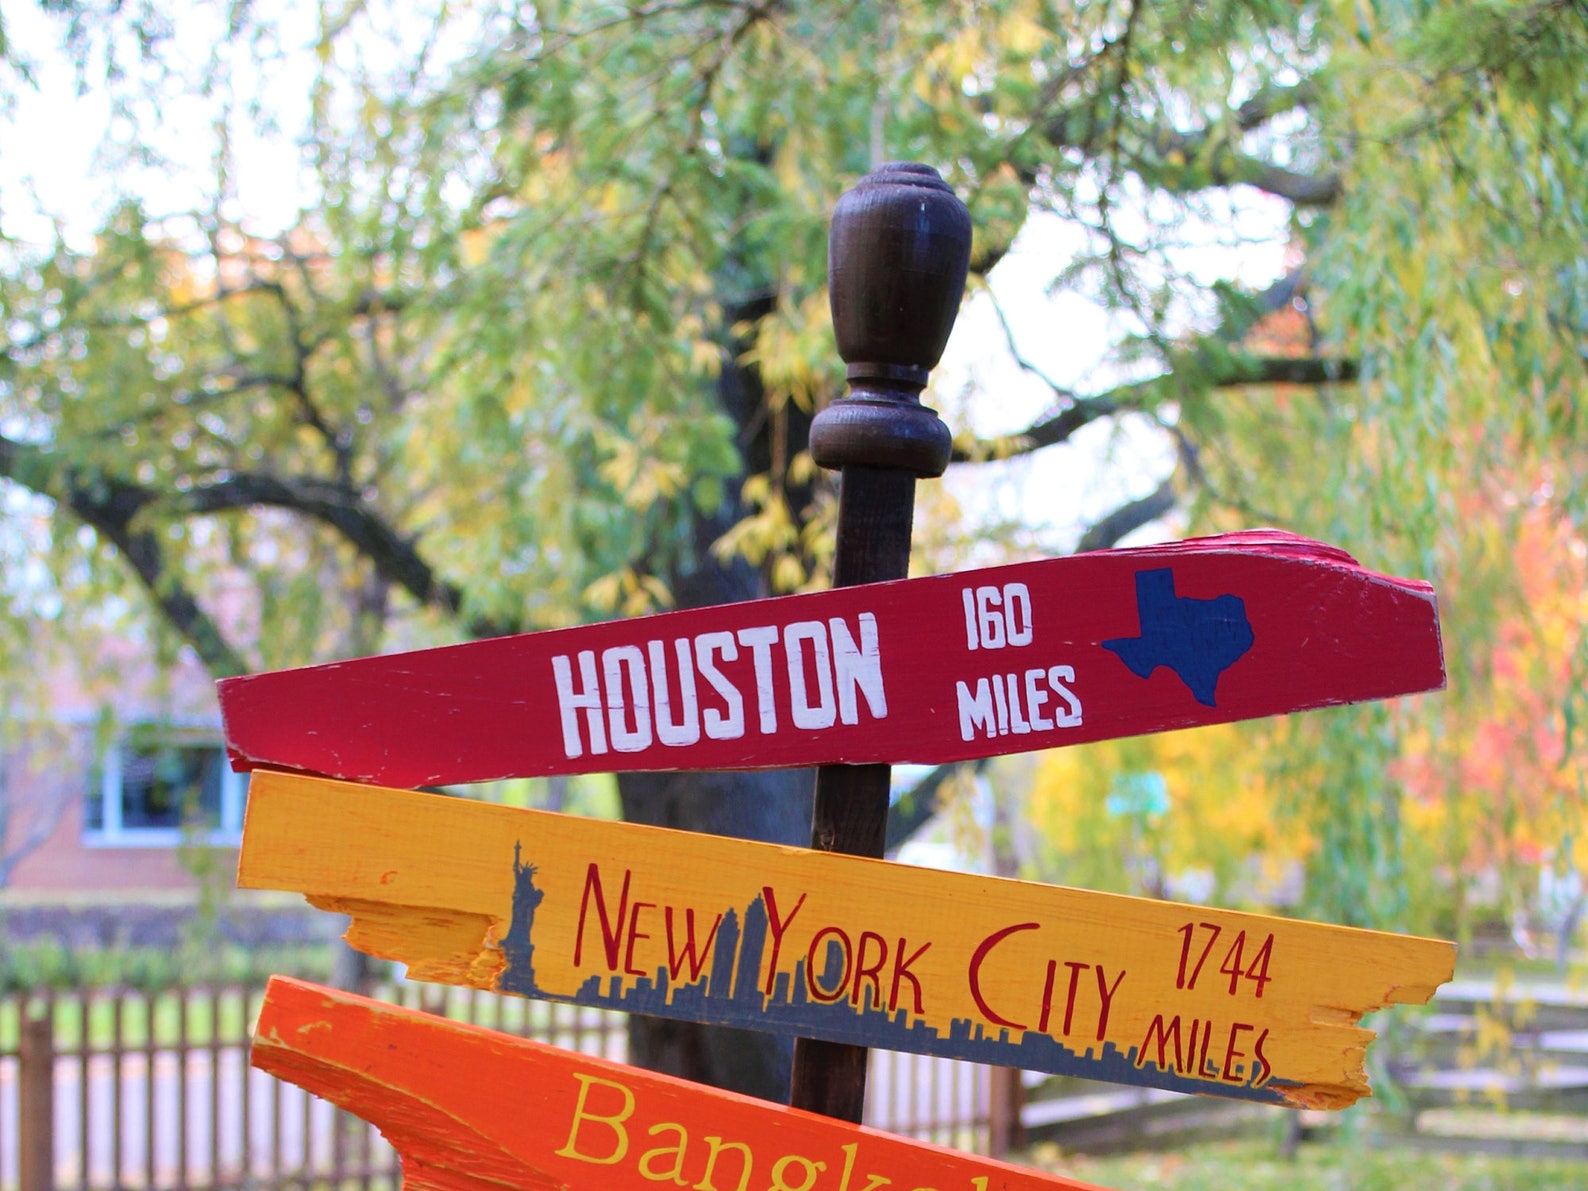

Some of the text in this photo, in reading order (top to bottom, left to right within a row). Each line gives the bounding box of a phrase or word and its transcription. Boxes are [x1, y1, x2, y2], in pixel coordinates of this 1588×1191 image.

[962, 582, 1033, 650] 160
[551, 612, 888, 758] HOUSTON
[956, 665, 1083, 741] MILES
[574, 863, 1127, 1042] NEW YORK CITY
[1176, 921, 1275, 998] 1744
[1137, 1013, 1272, 1087] MILES
